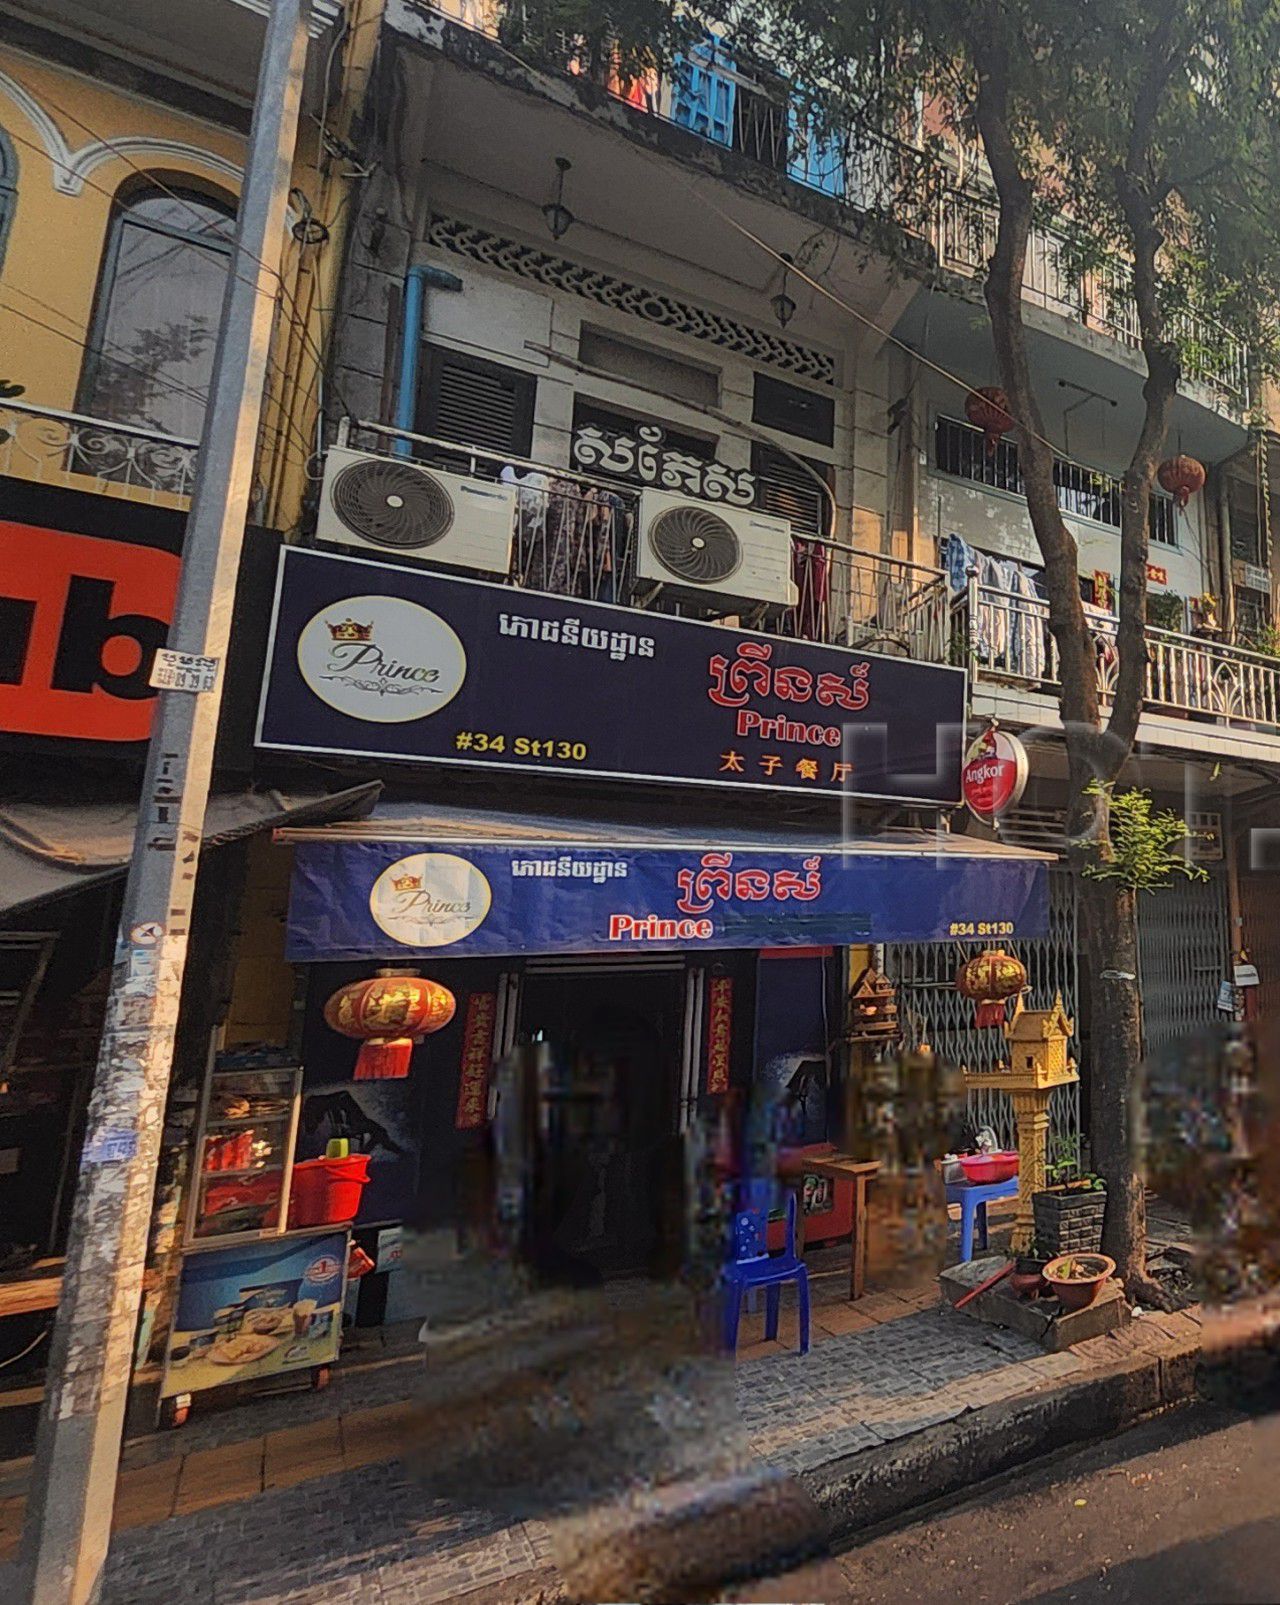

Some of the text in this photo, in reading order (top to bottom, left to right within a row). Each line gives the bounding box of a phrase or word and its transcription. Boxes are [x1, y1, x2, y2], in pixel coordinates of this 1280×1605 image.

[327, 643, 440, 683] Prince
[736, 709, 842, 748] Prince
[455, 731, 588, 761] #34 St130
[719, 751, 854, 782] 太子餐厅
[965, 764, 1005, 785] Angkor
[392, 889, 471, 914] Prince
[609, 914, 714, 941] Prince
[949, 921, 1014, 936] #34 St130
